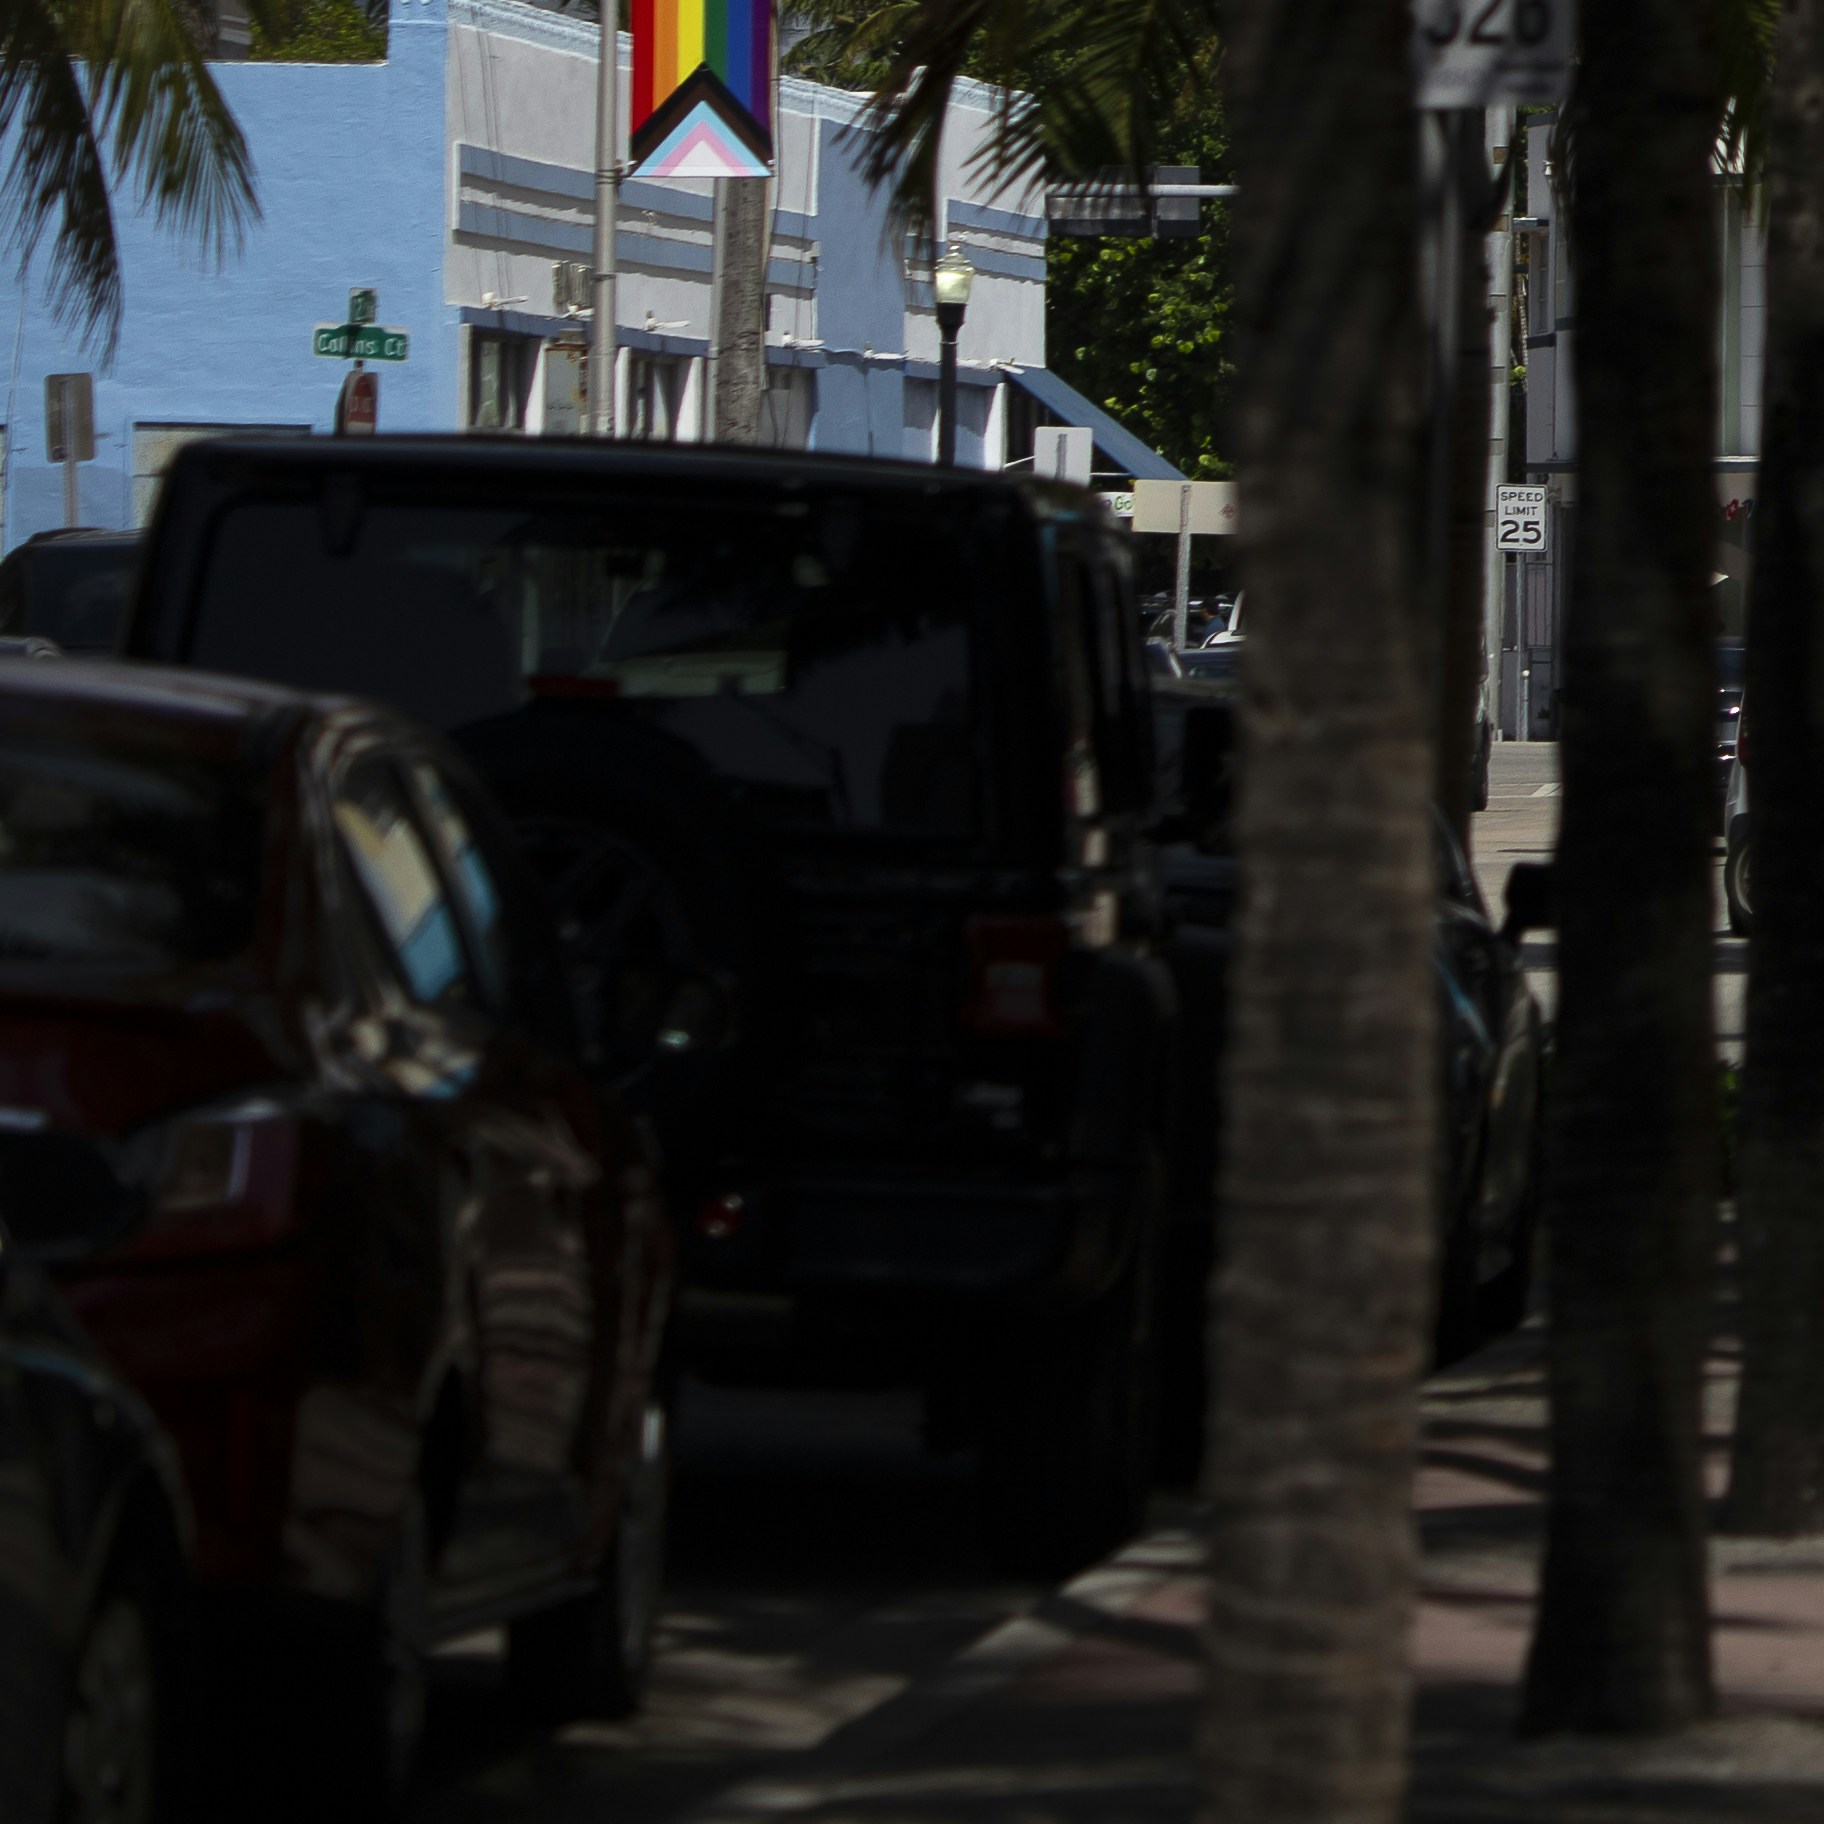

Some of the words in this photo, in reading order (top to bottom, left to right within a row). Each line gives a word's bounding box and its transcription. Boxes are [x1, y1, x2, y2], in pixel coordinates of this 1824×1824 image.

[1500, 491, 1543, 502] SPEED
[1504, 506, 1538, 516] LIMIT
[1500, 519, 1542, 544] 25
